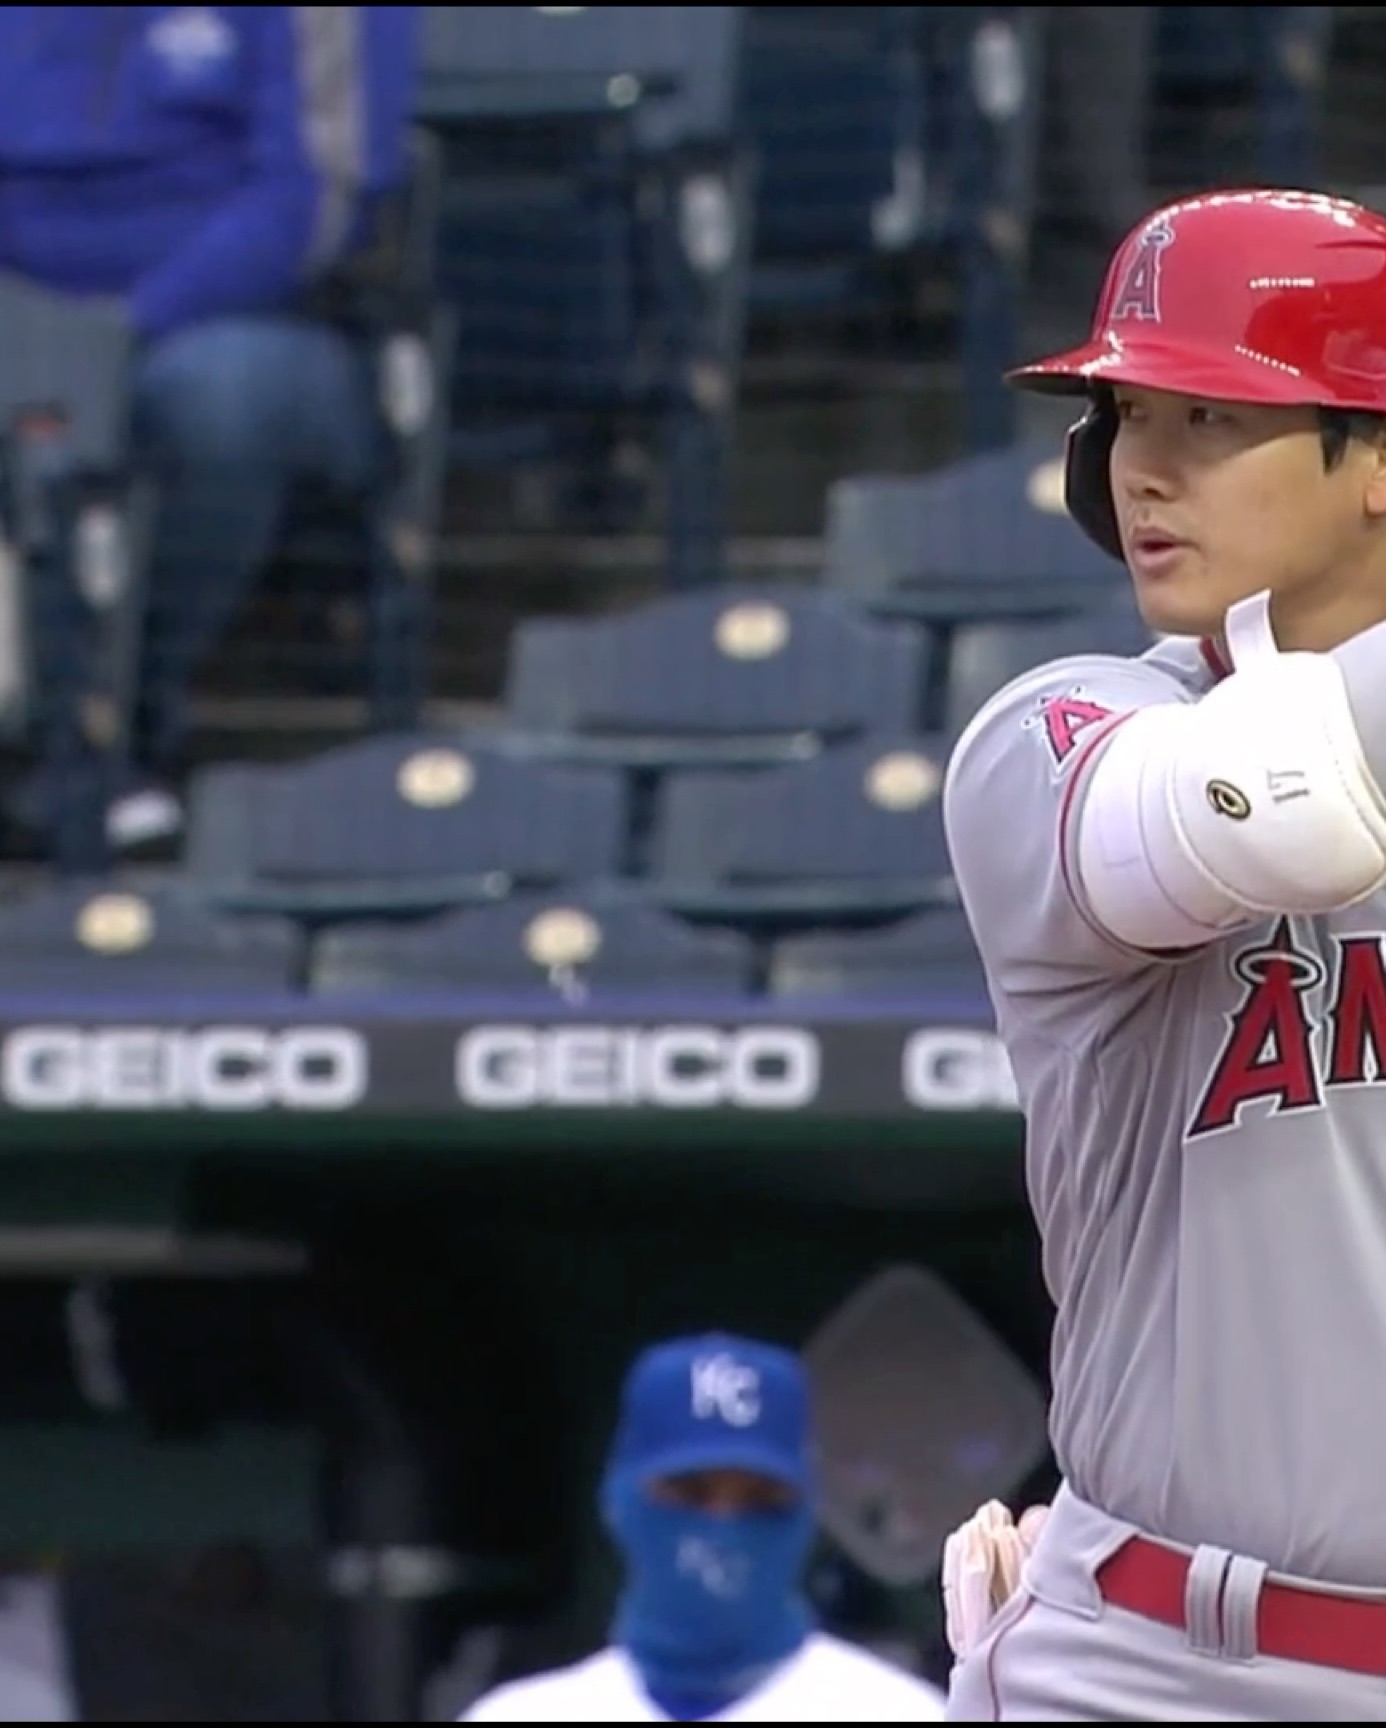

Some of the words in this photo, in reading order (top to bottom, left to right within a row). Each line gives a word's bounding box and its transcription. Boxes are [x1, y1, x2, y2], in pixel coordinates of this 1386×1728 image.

[3, 1026, 370, 1111] GEICO
[455, 1026, 818, 1111] GEICO
[690, 1353, 761, 1428] KC
